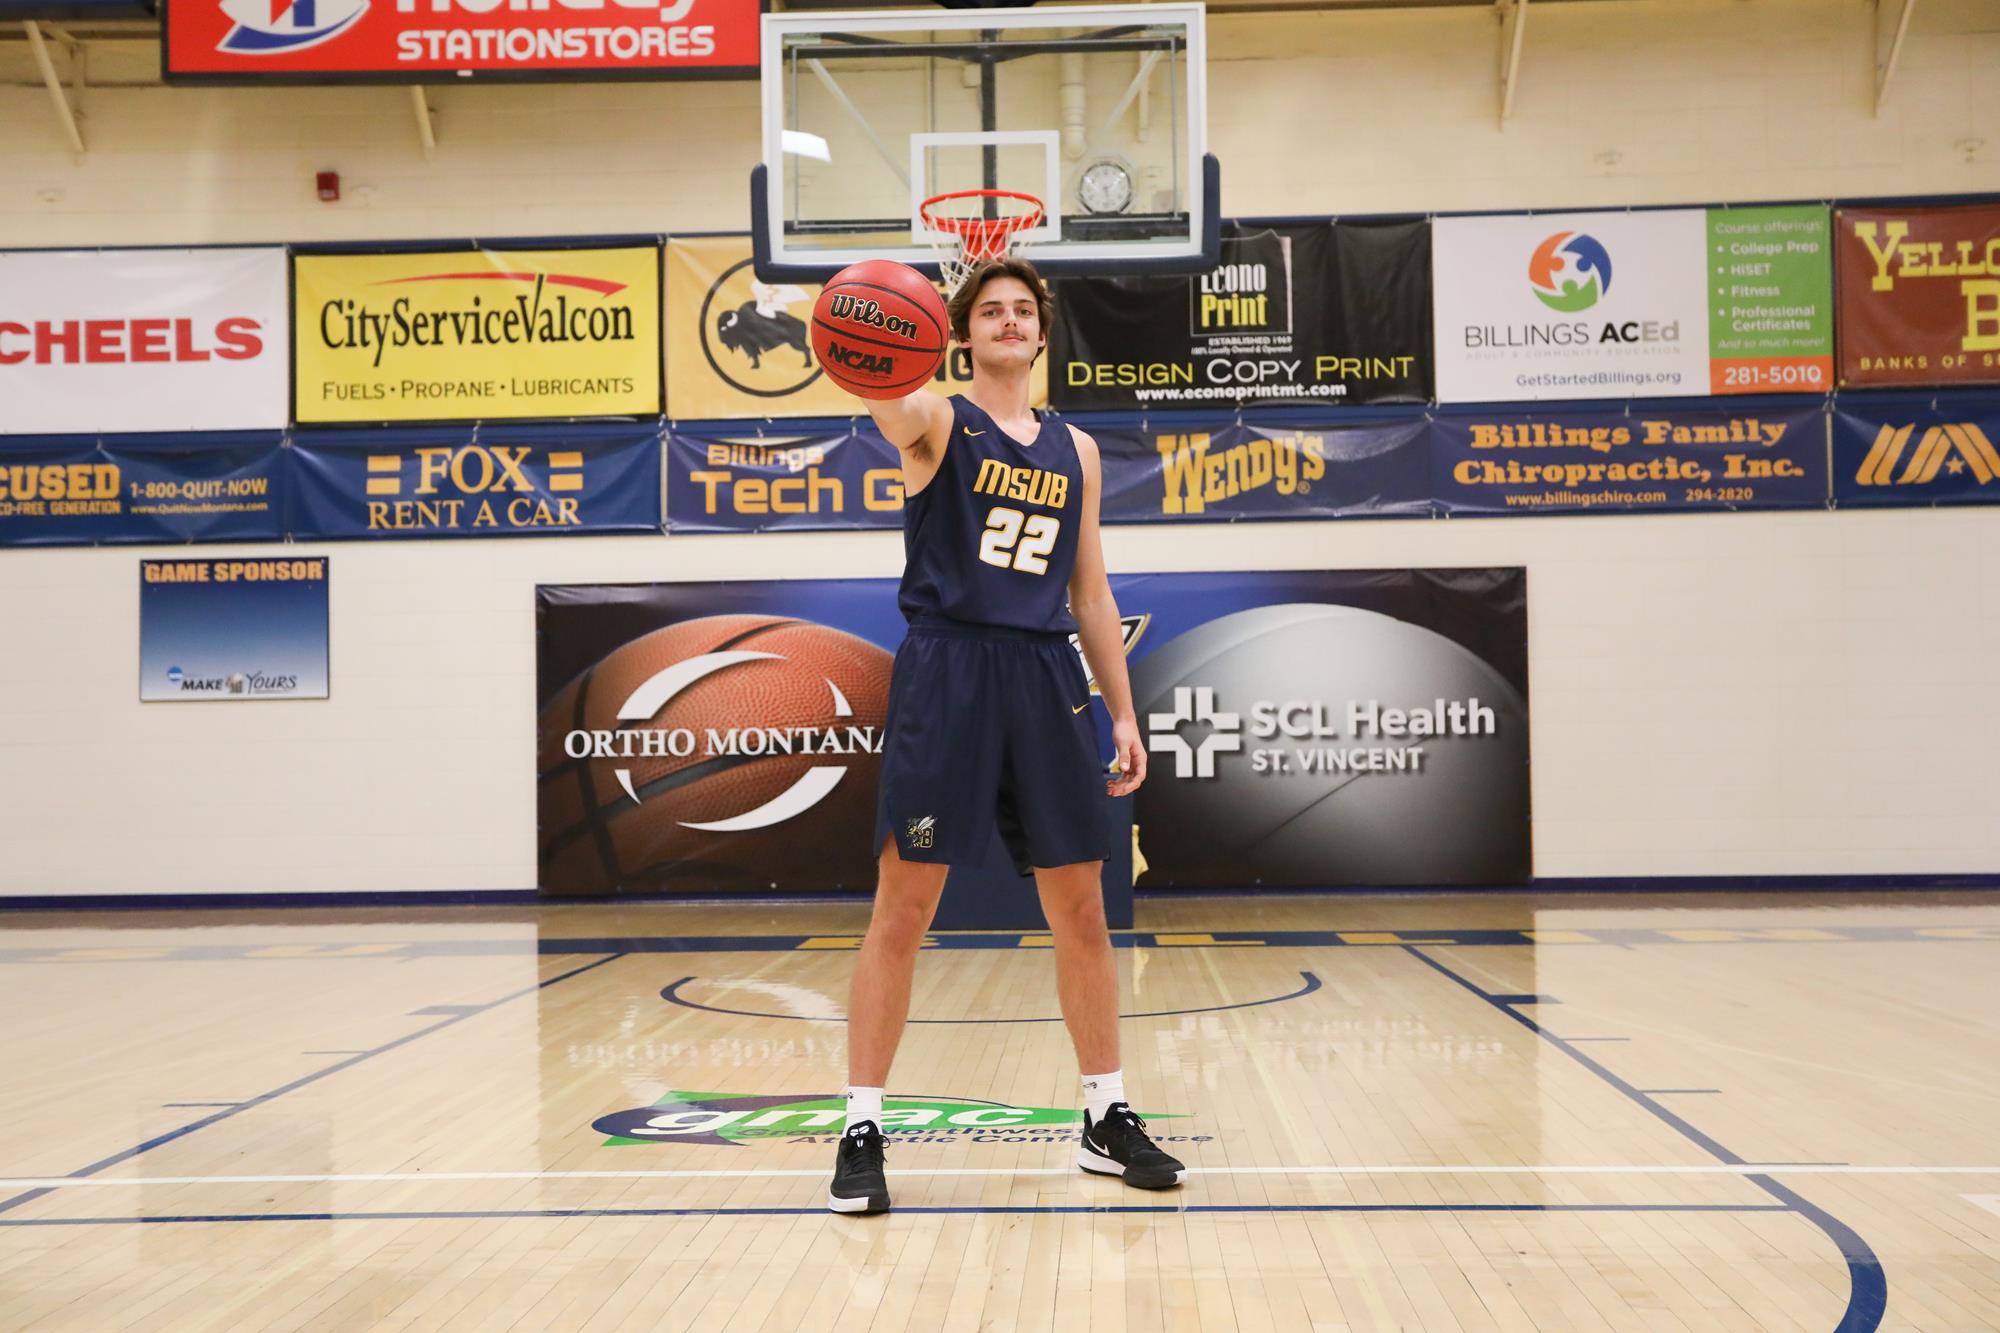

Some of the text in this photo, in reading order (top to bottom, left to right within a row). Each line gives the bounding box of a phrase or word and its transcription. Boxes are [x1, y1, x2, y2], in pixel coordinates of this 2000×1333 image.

[1716, 222, 1761, 234] Course
[1731, 240, 1819, 255] College Prep
[1731, 286, 1780, 297] Fitness
[320, 273, 635, 368] CityServiceValcon
[830, 293, 918, 341] Wilson
[1201, 292, 1268, 327] Print
[1732, 304, 1815, 318] Professional
[1465, 320, 1680, 348] BILLINGS ACEd
[1733, 319, 1811, 332] Certificates
[0, 317, 263, 365] CHEELS
[828, 341, 893, 375] NCAA
[1068, 356, 1415, 386] DESIGN COPY PRINT
[1860, 355, 1928, 370] BANKS
[1942, 354, 1967, 368] OF
[1516, 371, 1681, 387] GetStartedBillings.org
[1724, 365, 1822, 385] 281-5010
[322, 377, 635, 400] FUELS PROPANE LUBRICANTS
[1136, 384, 1346, 400] www.econoprintmt.com
[1469, 418, 1787, 453] Billings Family
[414, 445, 535, 494] FOX
[707, 443, 824, 474] Billings
[1453, 453, 1804, 486] Chiropractic, Inc.
[130, 478, 267, 499] 1-800-QUIT-NOW
[690, 467, 844, 514] Tech
[973, 458, 1069, 509] MSUB
[50, 501, 121, 515] GENERATION
[1505, 487, 1753, 507] www.billingschiro.com 294-2820
[367, 498, 582, 530] RENT A CAR
[979, 506, 1060, 576] 22
[145, 560, 323, 583] GAME SPONSOR
[181, 679, 223, 691] MAKE
[1250, 698, 1497, 738] SCL Health
[564, 728, 696, 759] ORTHO
[1252, 747, 1424, 772] ST. VINCENT
[629, 1108, 1033, 1135] gnac
[736, 1127, 1084, 1137] Grea Northwes
[786, 1136, 958, 1144] Atetic
